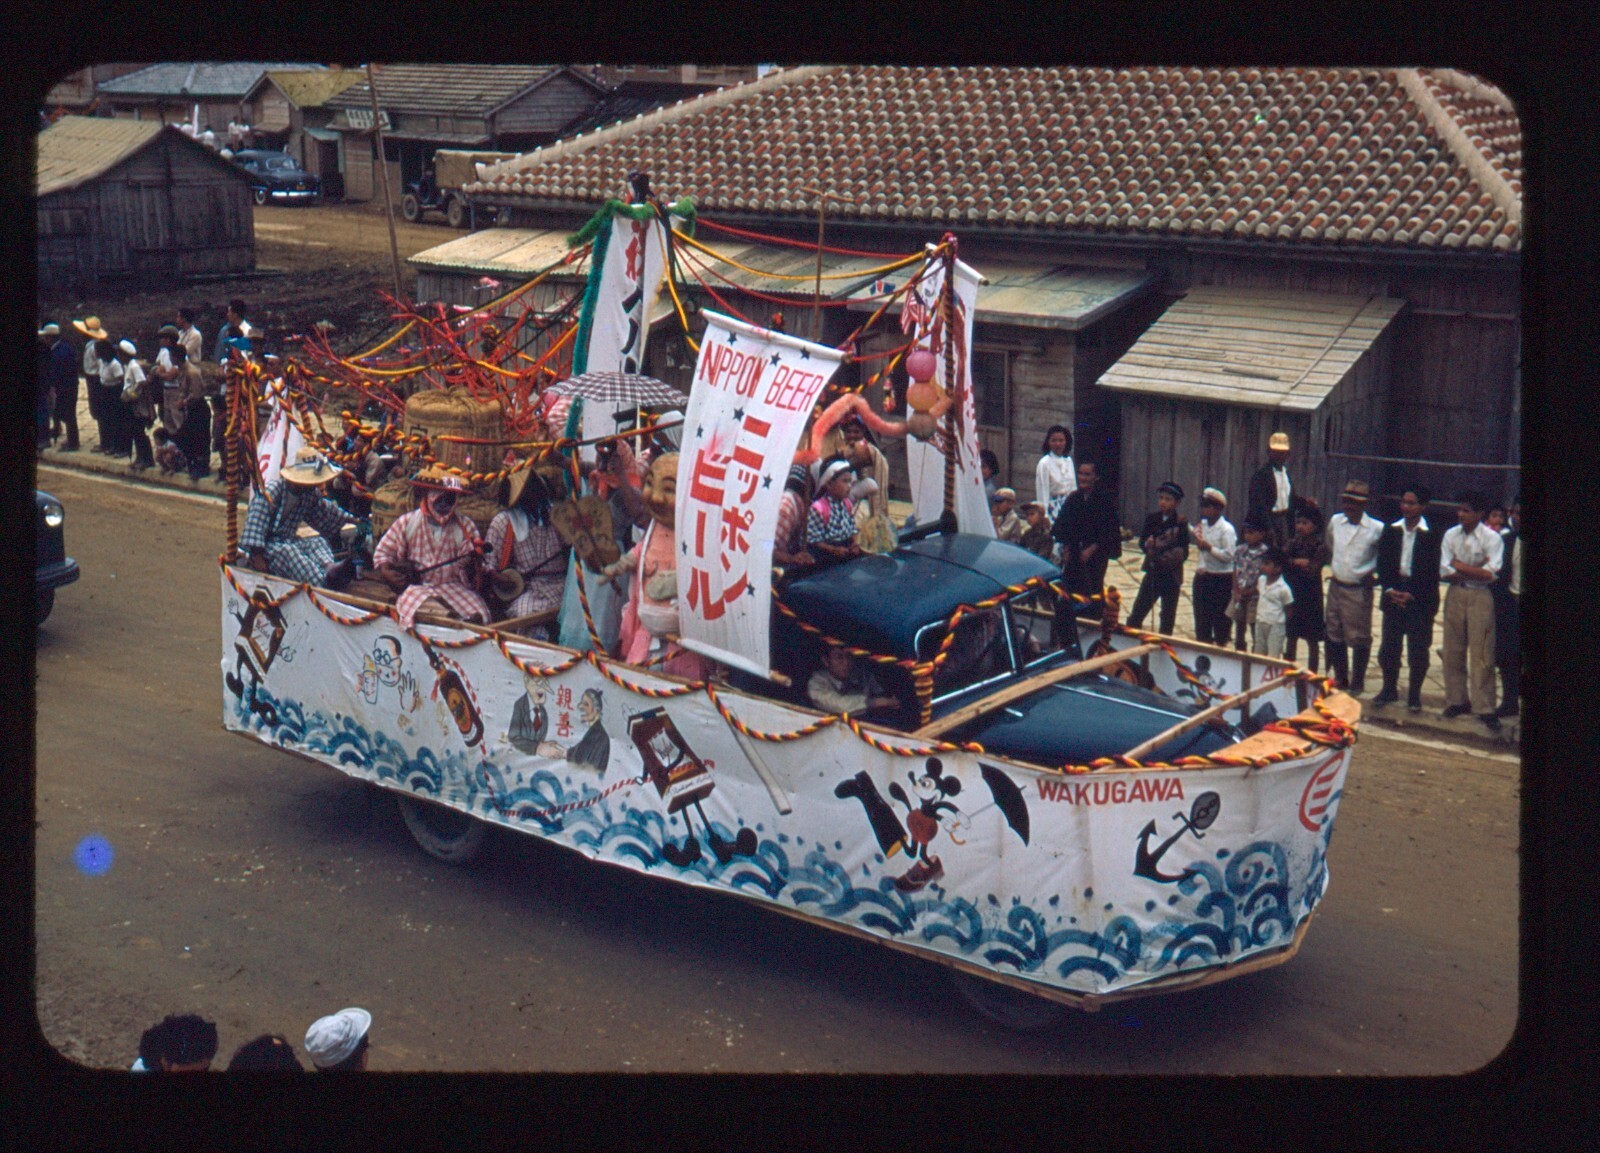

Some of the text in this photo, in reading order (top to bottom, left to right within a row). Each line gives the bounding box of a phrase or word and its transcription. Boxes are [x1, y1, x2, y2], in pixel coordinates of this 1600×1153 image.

[699, 340, 824, 412] NIPPON BEER
[687, 449, 731, 621] ビール
[722, 415, 771, 603] ニッポン
[1036, 778, 1184, 806] WAKUGAWA
